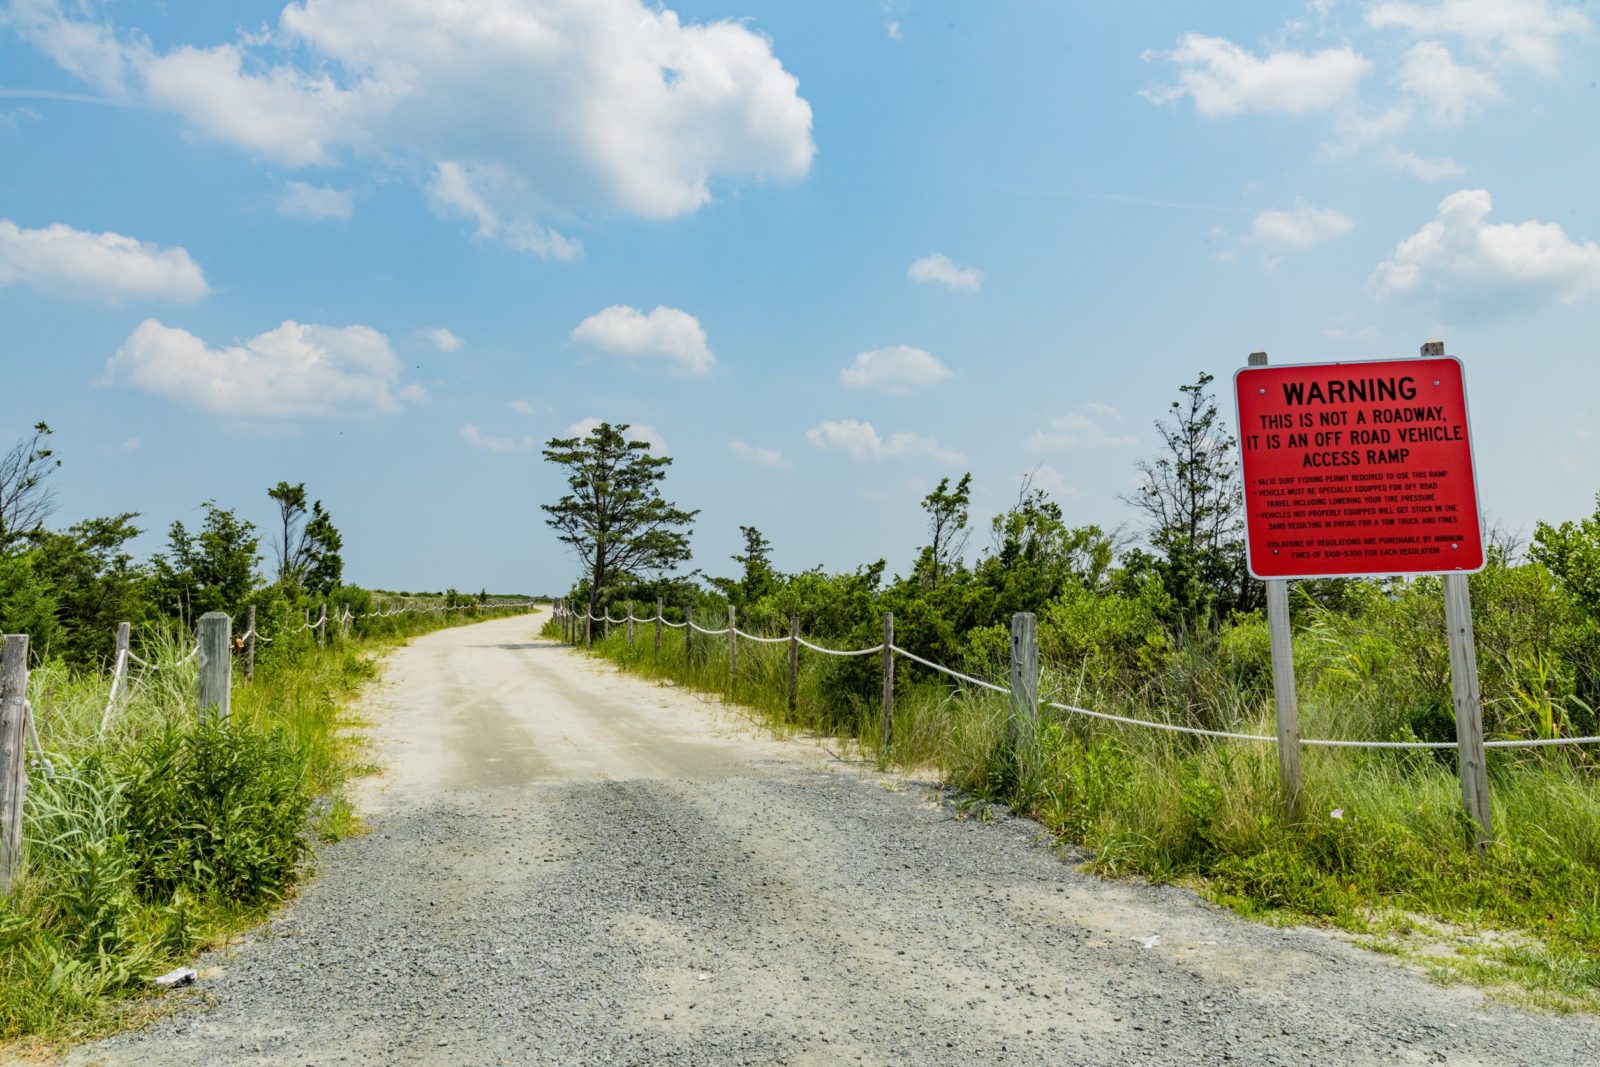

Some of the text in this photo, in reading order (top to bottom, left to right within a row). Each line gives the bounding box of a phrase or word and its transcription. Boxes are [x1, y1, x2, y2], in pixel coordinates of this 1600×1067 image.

[1283, 377, 1417, 406] WARNING
[1260, 406, 1447, 429] THIS IS NOT A ROADWAY,
[1247, 426, 1463, 449] IT IS AN OFF ROAD VEHICLE
[1303, 449, 1409, 467] ACCESS RAMP
